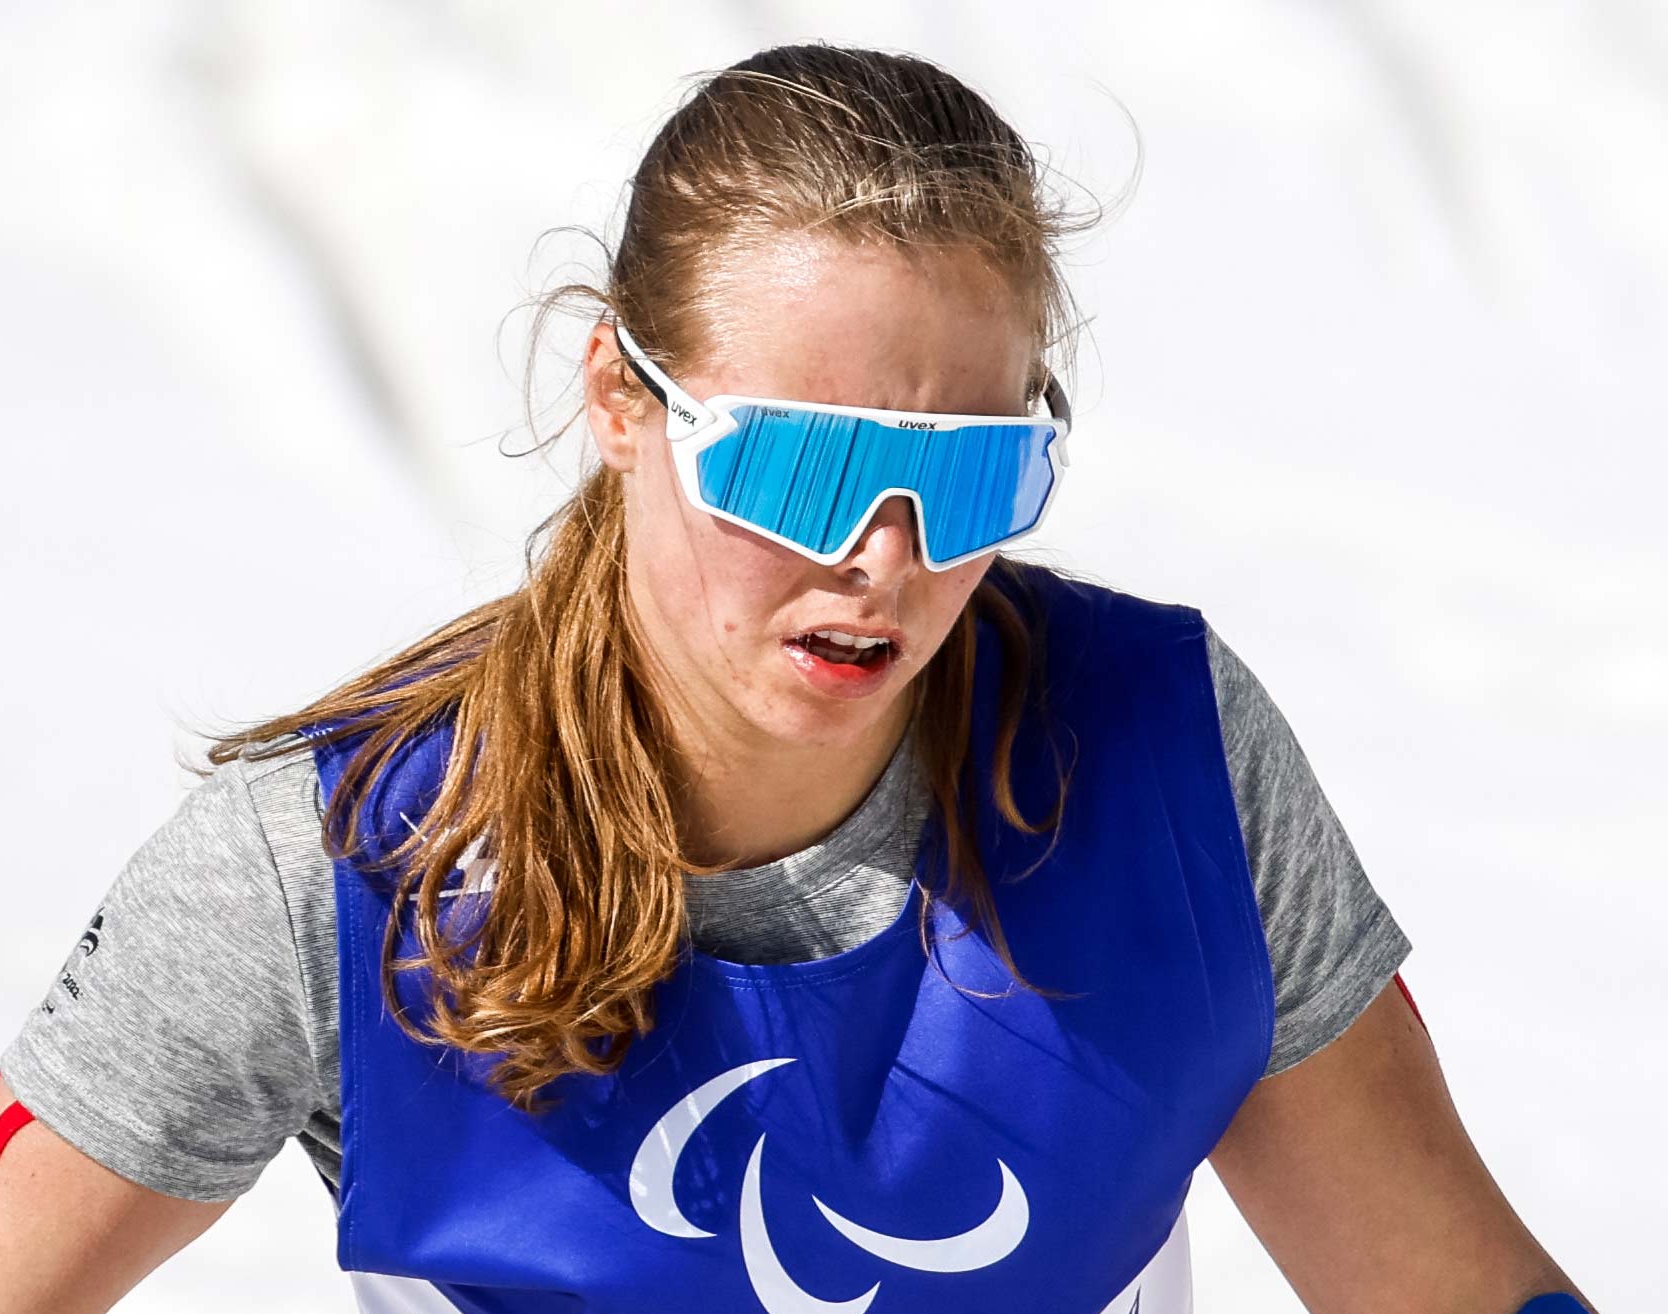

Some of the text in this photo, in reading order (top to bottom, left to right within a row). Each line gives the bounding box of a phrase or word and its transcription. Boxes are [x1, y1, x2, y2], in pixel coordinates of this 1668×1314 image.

[670, 399, 698, 427] uvex
[760, 406, 790, 419] uvex
[897, 419, 938, 431] uvex
